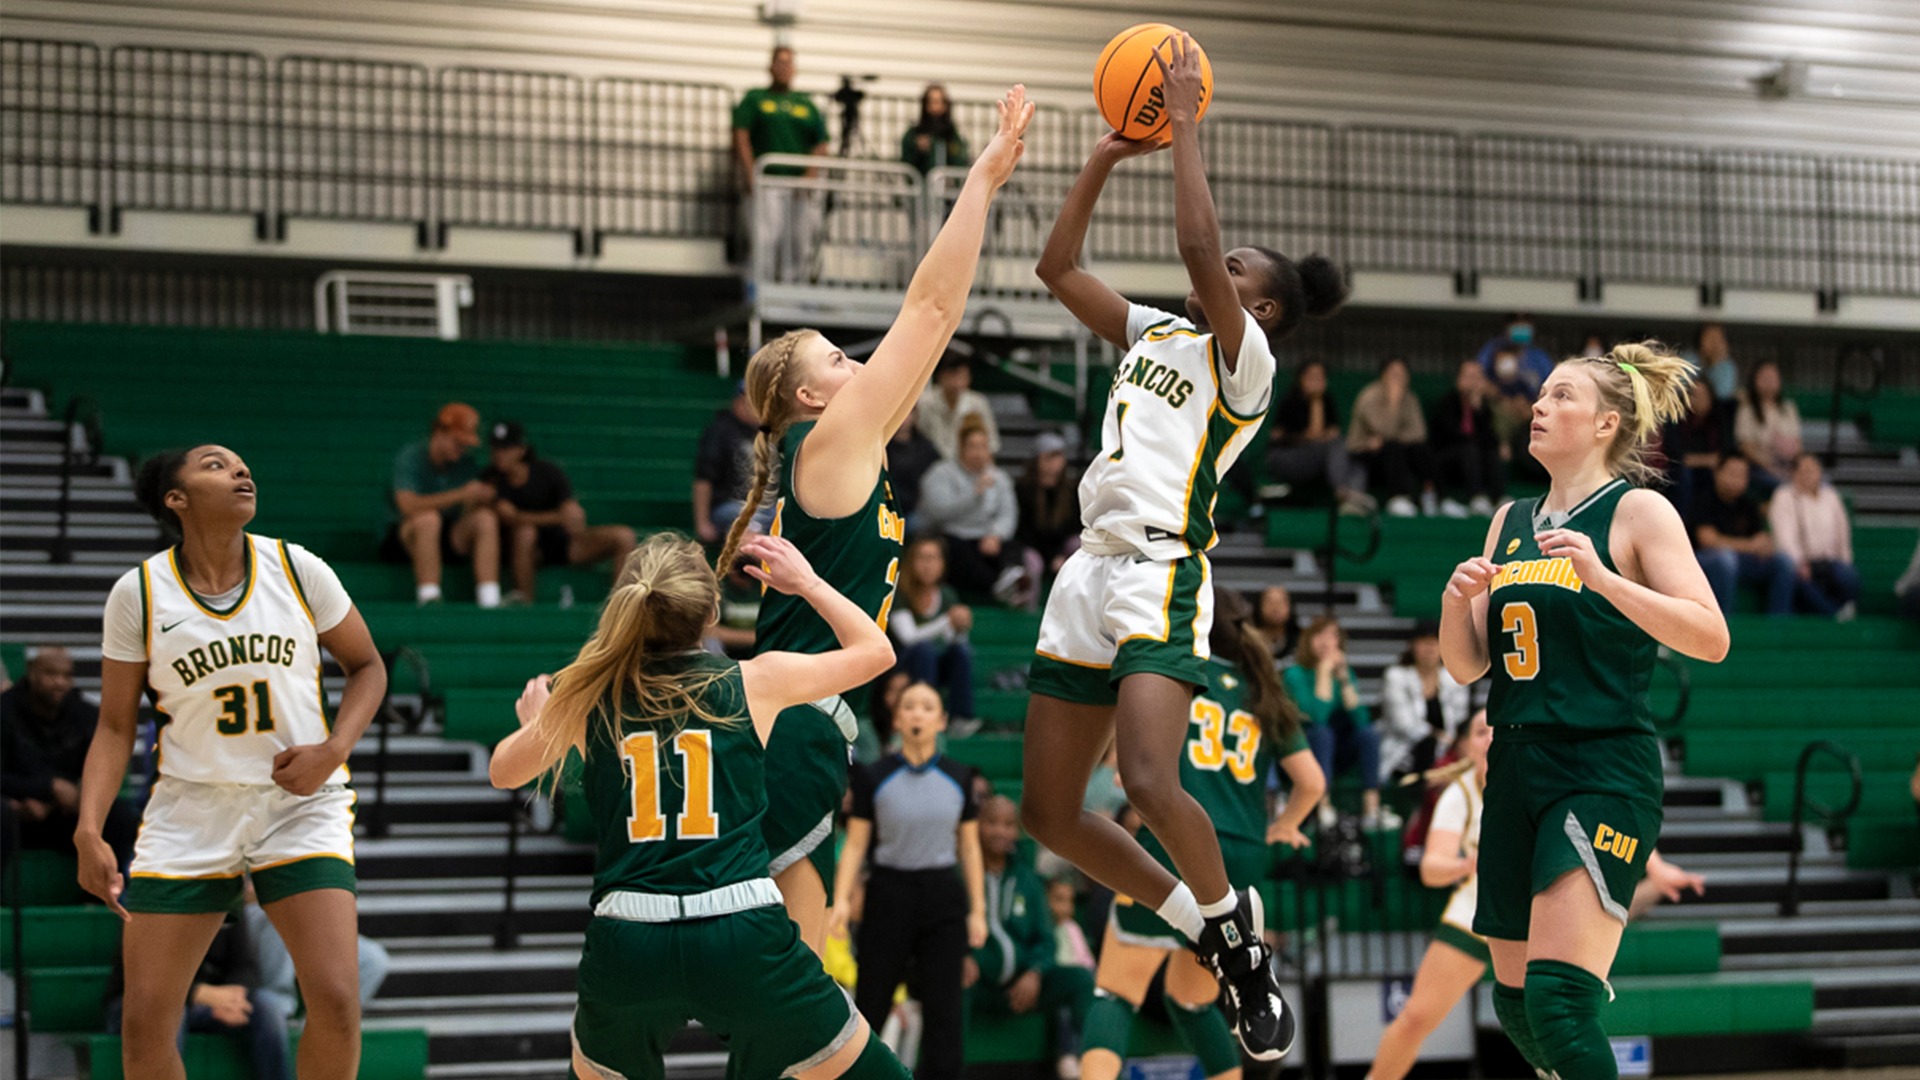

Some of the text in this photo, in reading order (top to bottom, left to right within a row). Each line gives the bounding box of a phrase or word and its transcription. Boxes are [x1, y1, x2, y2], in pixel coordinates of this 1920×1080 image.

[1134, 82, 1166, 127] Wil
[171, 633, 296, 687] BRONCOS
[1501, 601, 1540, 681] 3
[213, 678, 276, 737] 31
[1188, 695, 1261, 785] 33
[620, 729, 719, 843] 11
[1593, 822, 1639, 864] CUI
